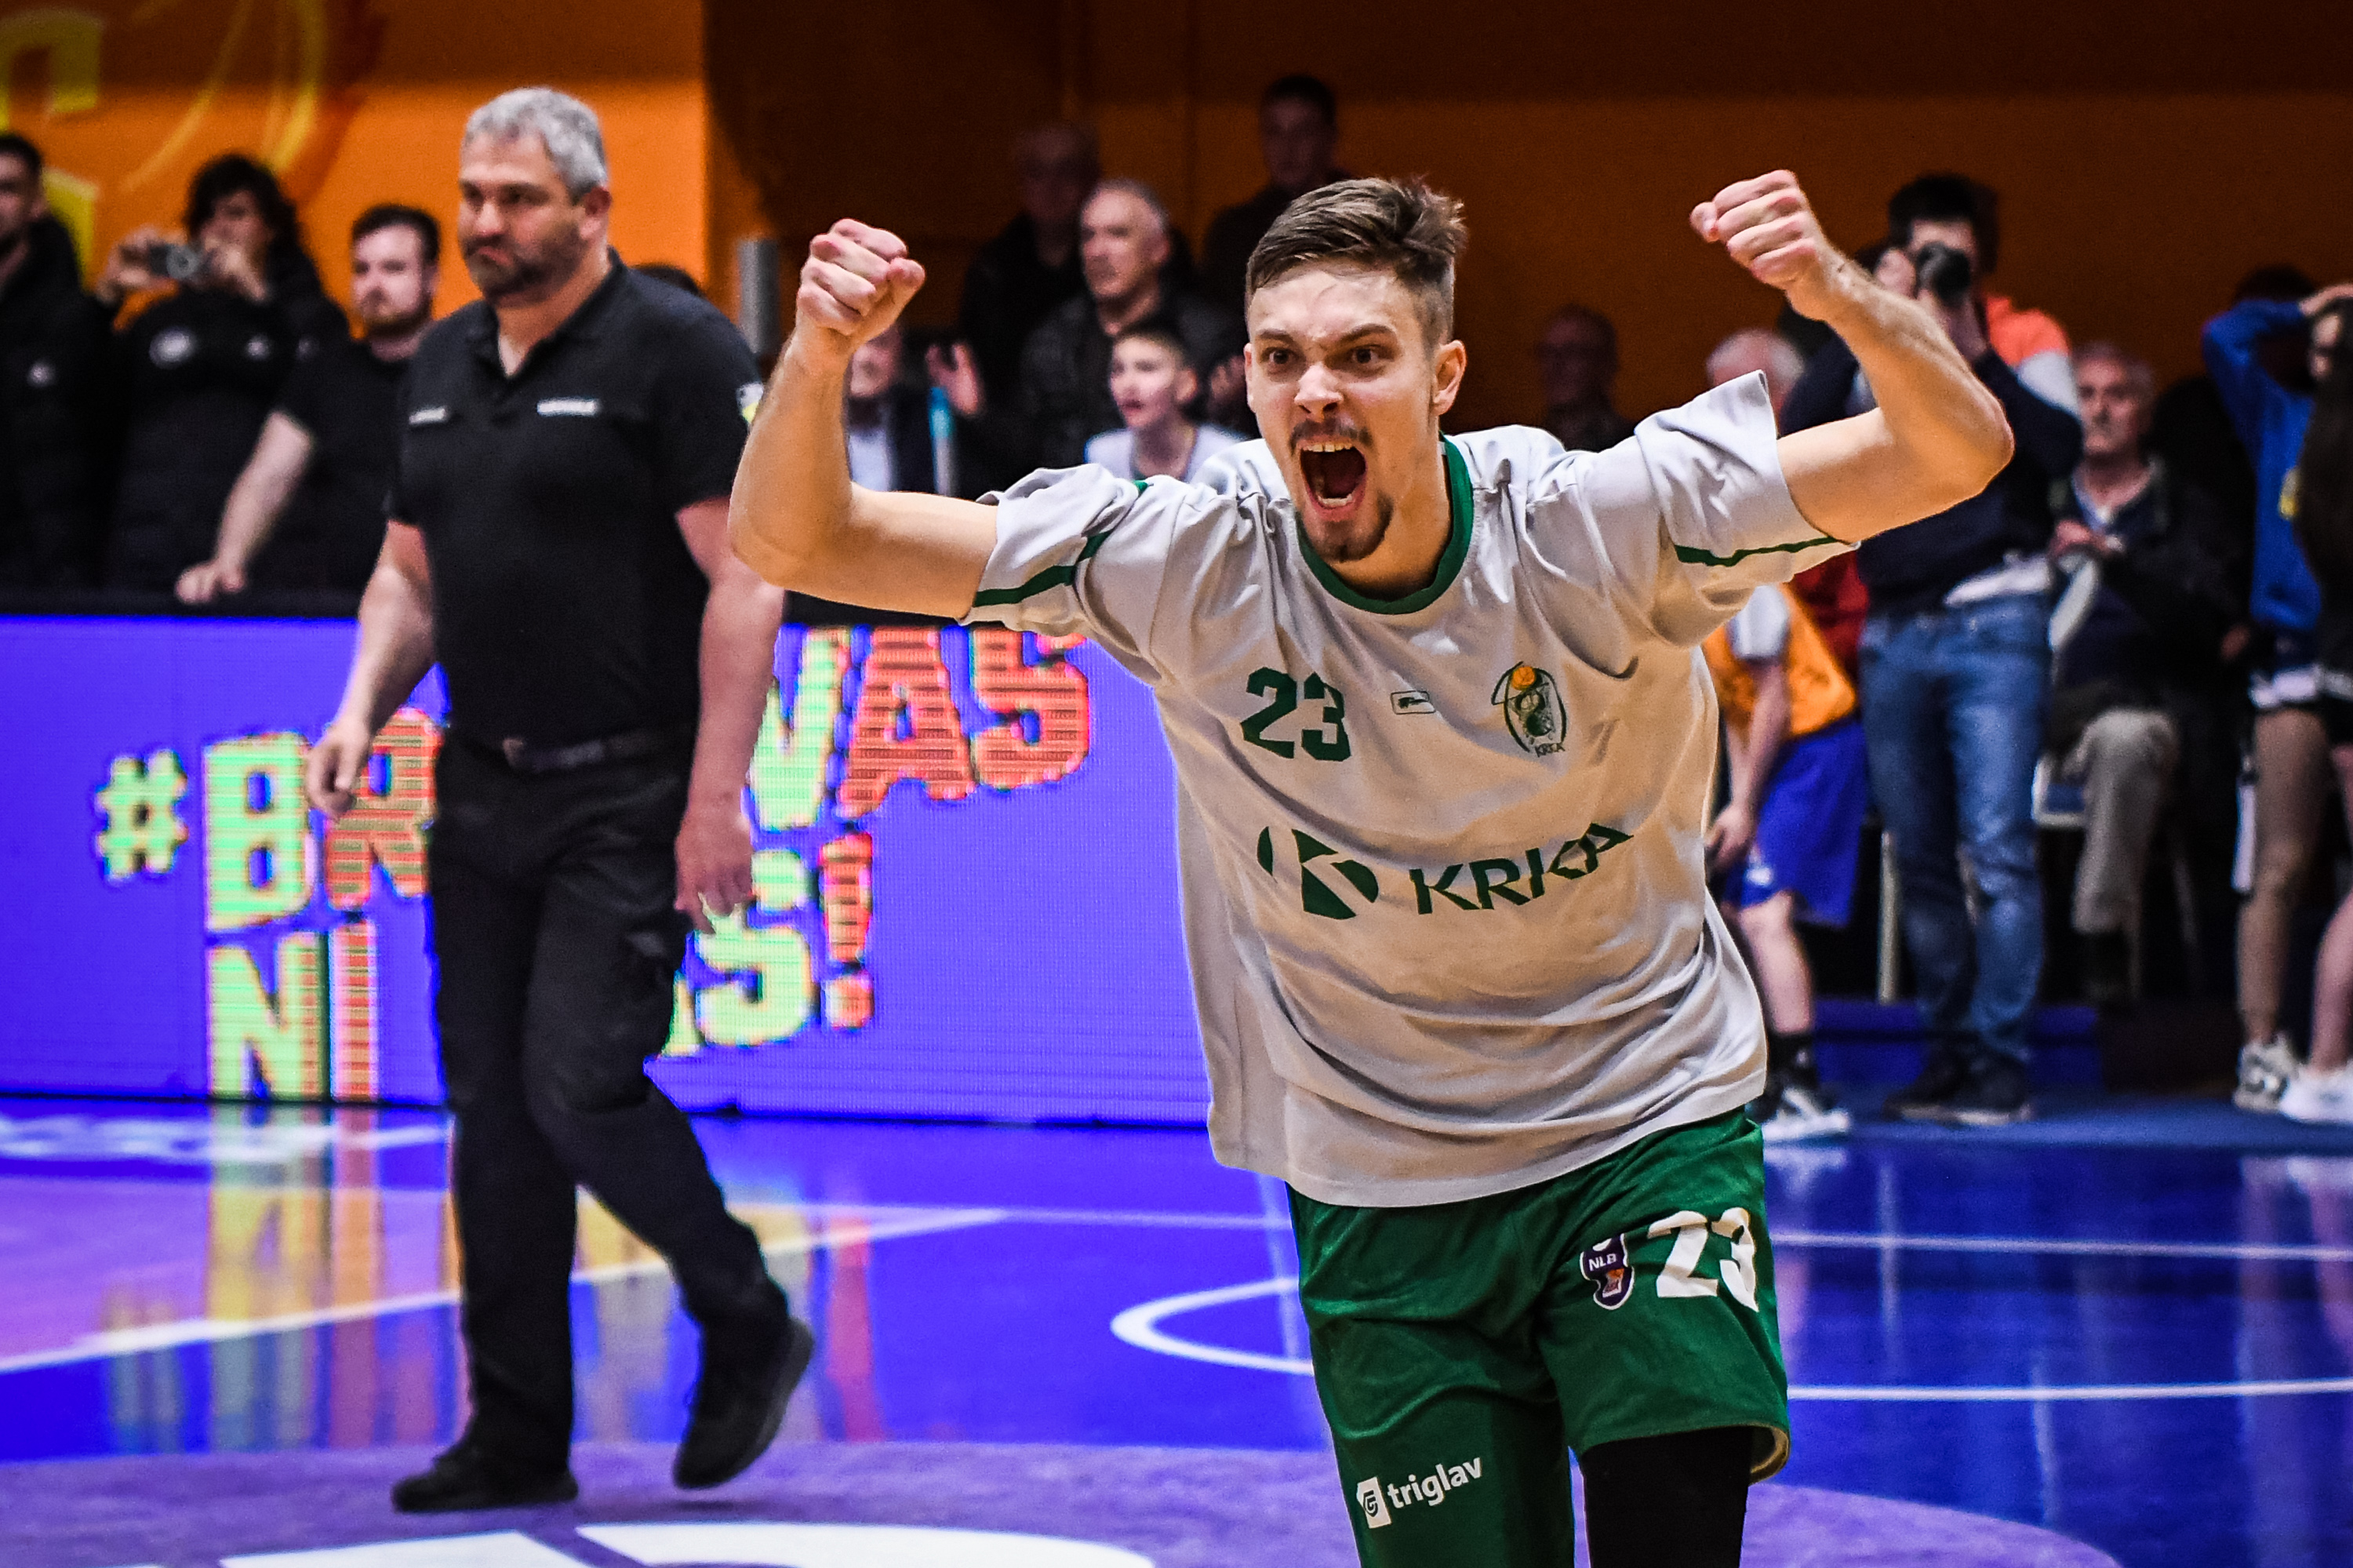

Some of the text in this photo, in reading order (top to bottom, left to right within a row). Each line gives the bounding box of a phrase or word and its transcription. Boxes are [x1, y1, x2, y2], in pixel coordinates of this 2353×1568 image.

[748, 625, 1091, 828] VAS
[1240, 667, 1352, 762] 23
[1409, 822, 1635, 915] KRKA
[1588, 1253, 1617, 1271] NLB
[1648, 1207, 1759, 1312] 23
[1387, 1457, 1482, 1507] triglav
